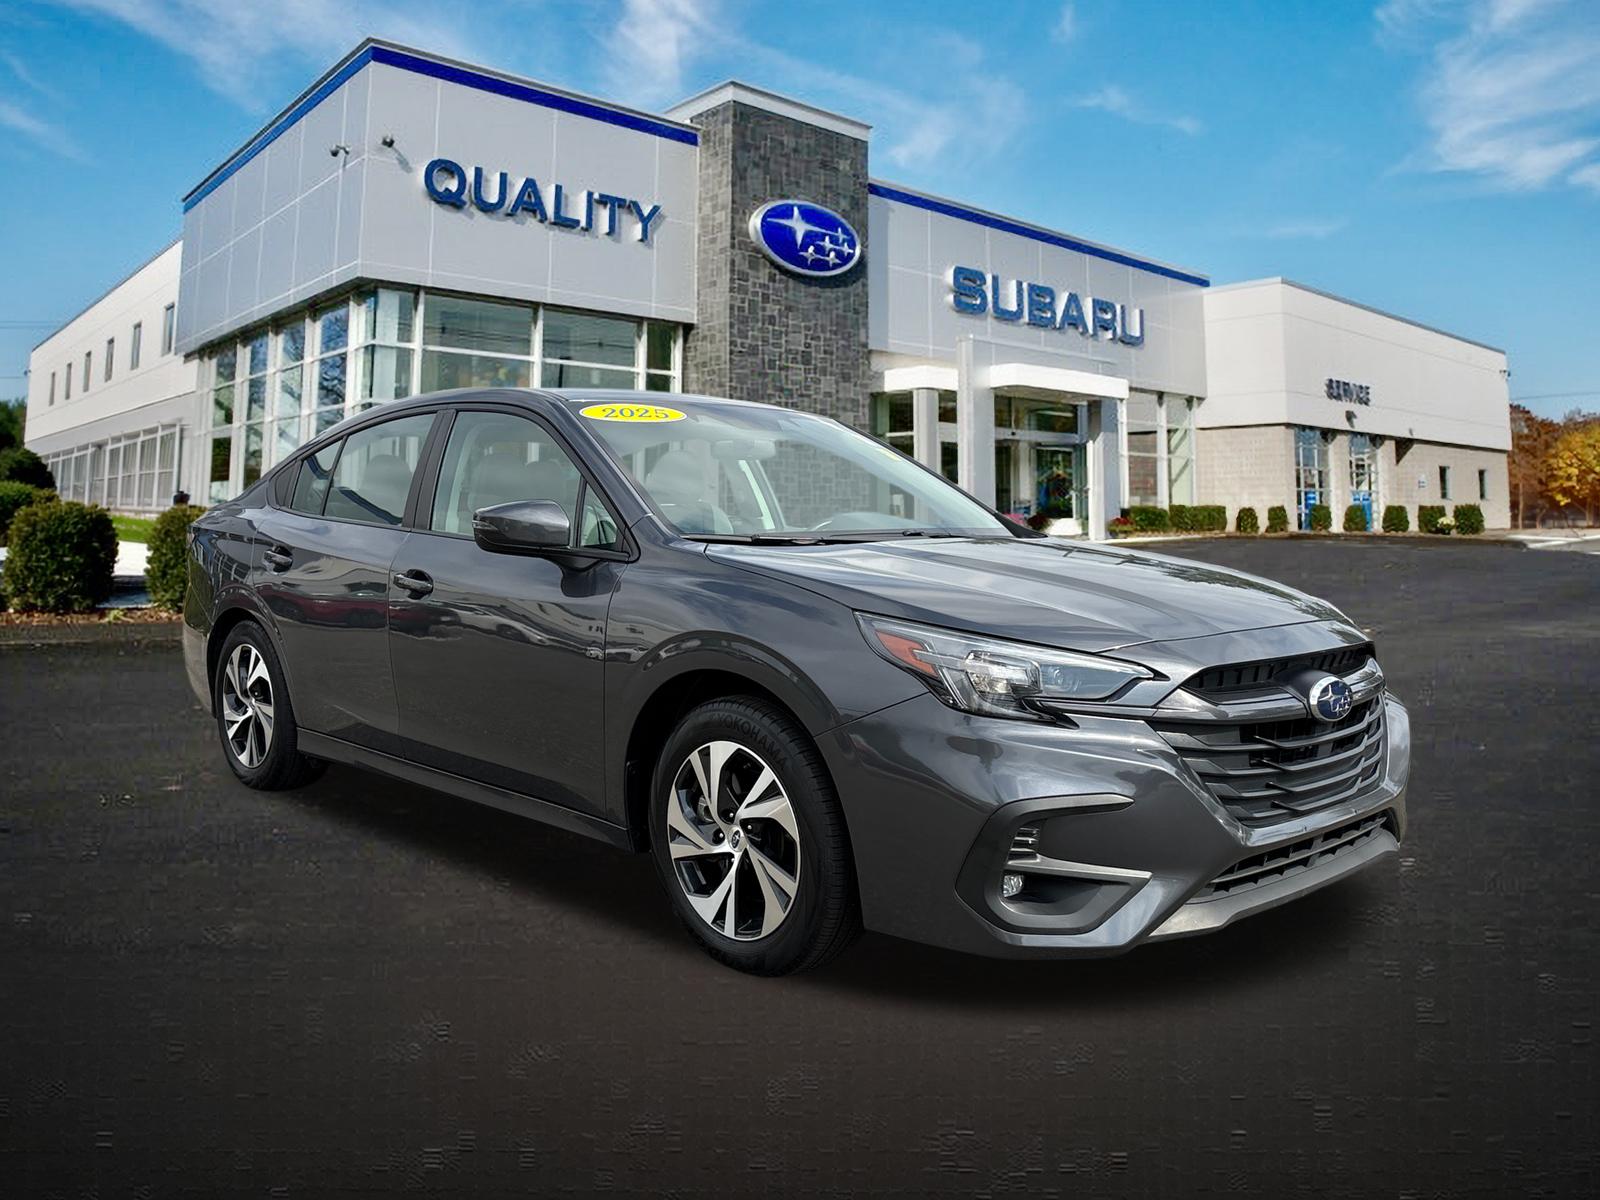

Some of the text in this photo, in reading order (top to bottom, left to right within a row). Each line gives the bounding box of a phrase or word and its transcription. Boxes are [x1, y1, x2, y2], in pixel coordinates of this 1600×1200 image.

[423, 158, 662, 242] QUALITY
[949, 264, 1145, 347] SUBARU
[602, 406, 670, 419] 2025
[1325, 377, 1371, 406] SERVICE
[716, 711, 789, 768] YOKOHAMA
